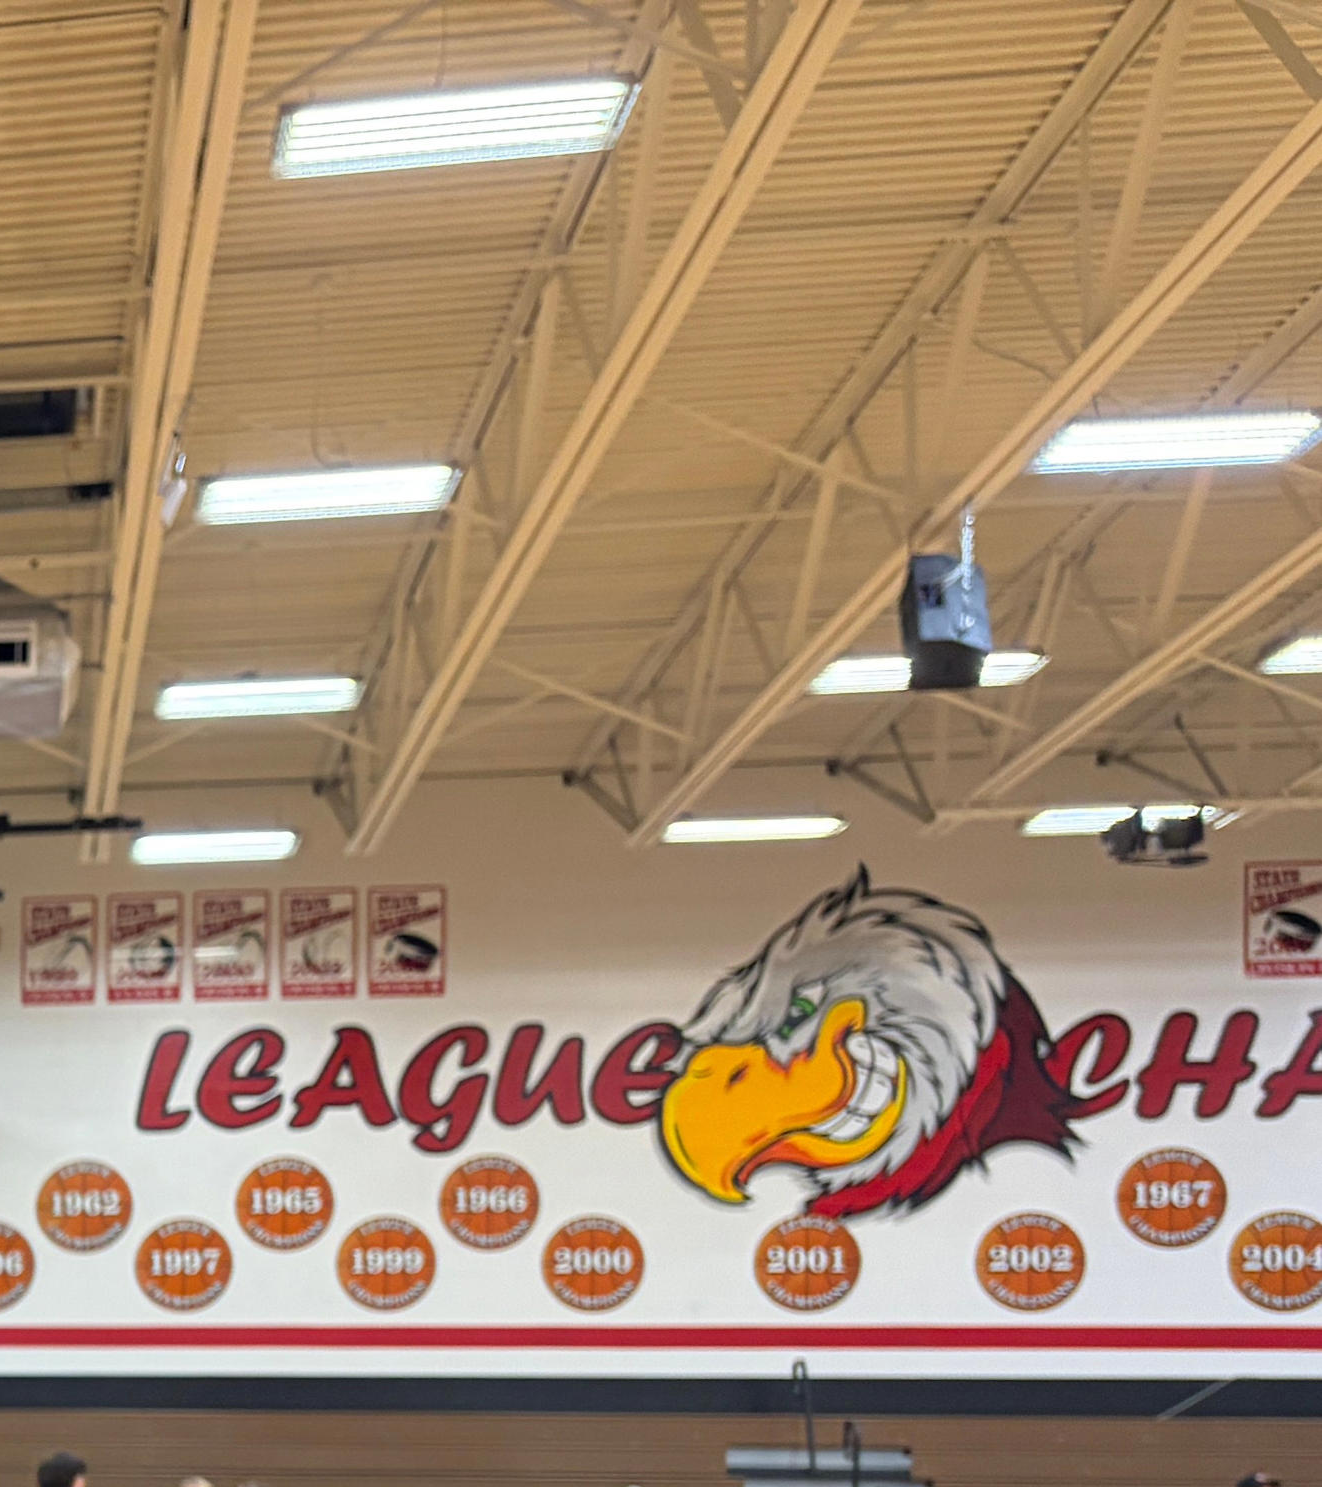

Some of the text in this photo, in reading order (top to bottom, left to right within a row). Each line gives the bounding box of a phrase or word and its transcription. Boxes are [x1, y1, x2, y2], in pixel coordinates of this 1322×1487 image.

[136, 1021, 683, 1154] LEAGUE
[52, 1189, 122, 1217] 1962
[251, 1186, 324, 1214] 1965
[455, 1185, 529, 1213] 1966
[1132, 1179, 1215, 1209] 1967
[151, 1248, 222, 1276] 1997
[351, 1246, 425, 1275] 1999
[554, 1246, 633, 1275] 2000
[766, 1245, 847, 1274] 2001
[987, 1243, 1075, 1272] 2002
[1241, 1243, 1322, 1273] 2004
